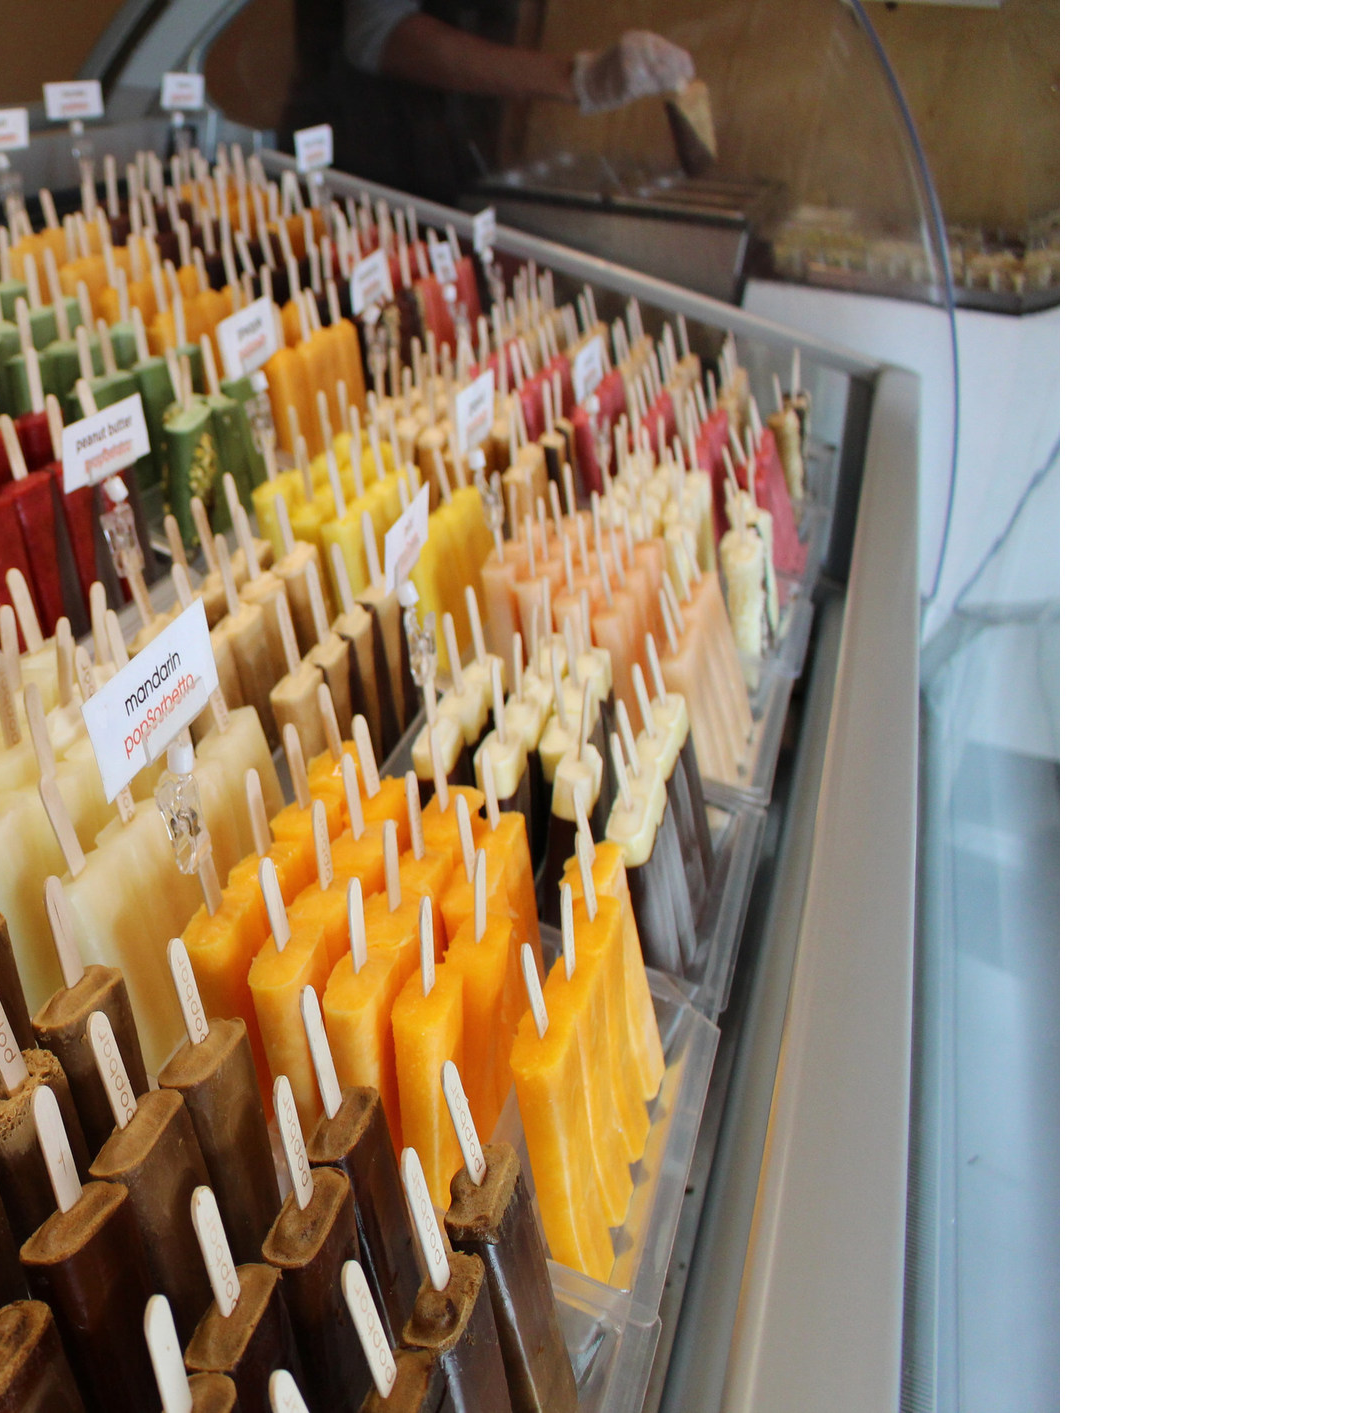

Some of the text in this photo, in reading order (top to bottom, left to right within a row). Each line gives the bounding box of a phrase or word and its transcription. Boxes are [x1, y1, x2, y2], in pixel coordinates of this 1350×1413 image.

[123, 673, 196, 760] popSorbetto
[124, 652, 182, 716] mandarin
[283, 1097, 310, 1187] popbar
[450, 1086, 482, 1174] popbar
[411, 1172, 443, 1266] popbar
[354, 1283, 396, 1384] popbar
